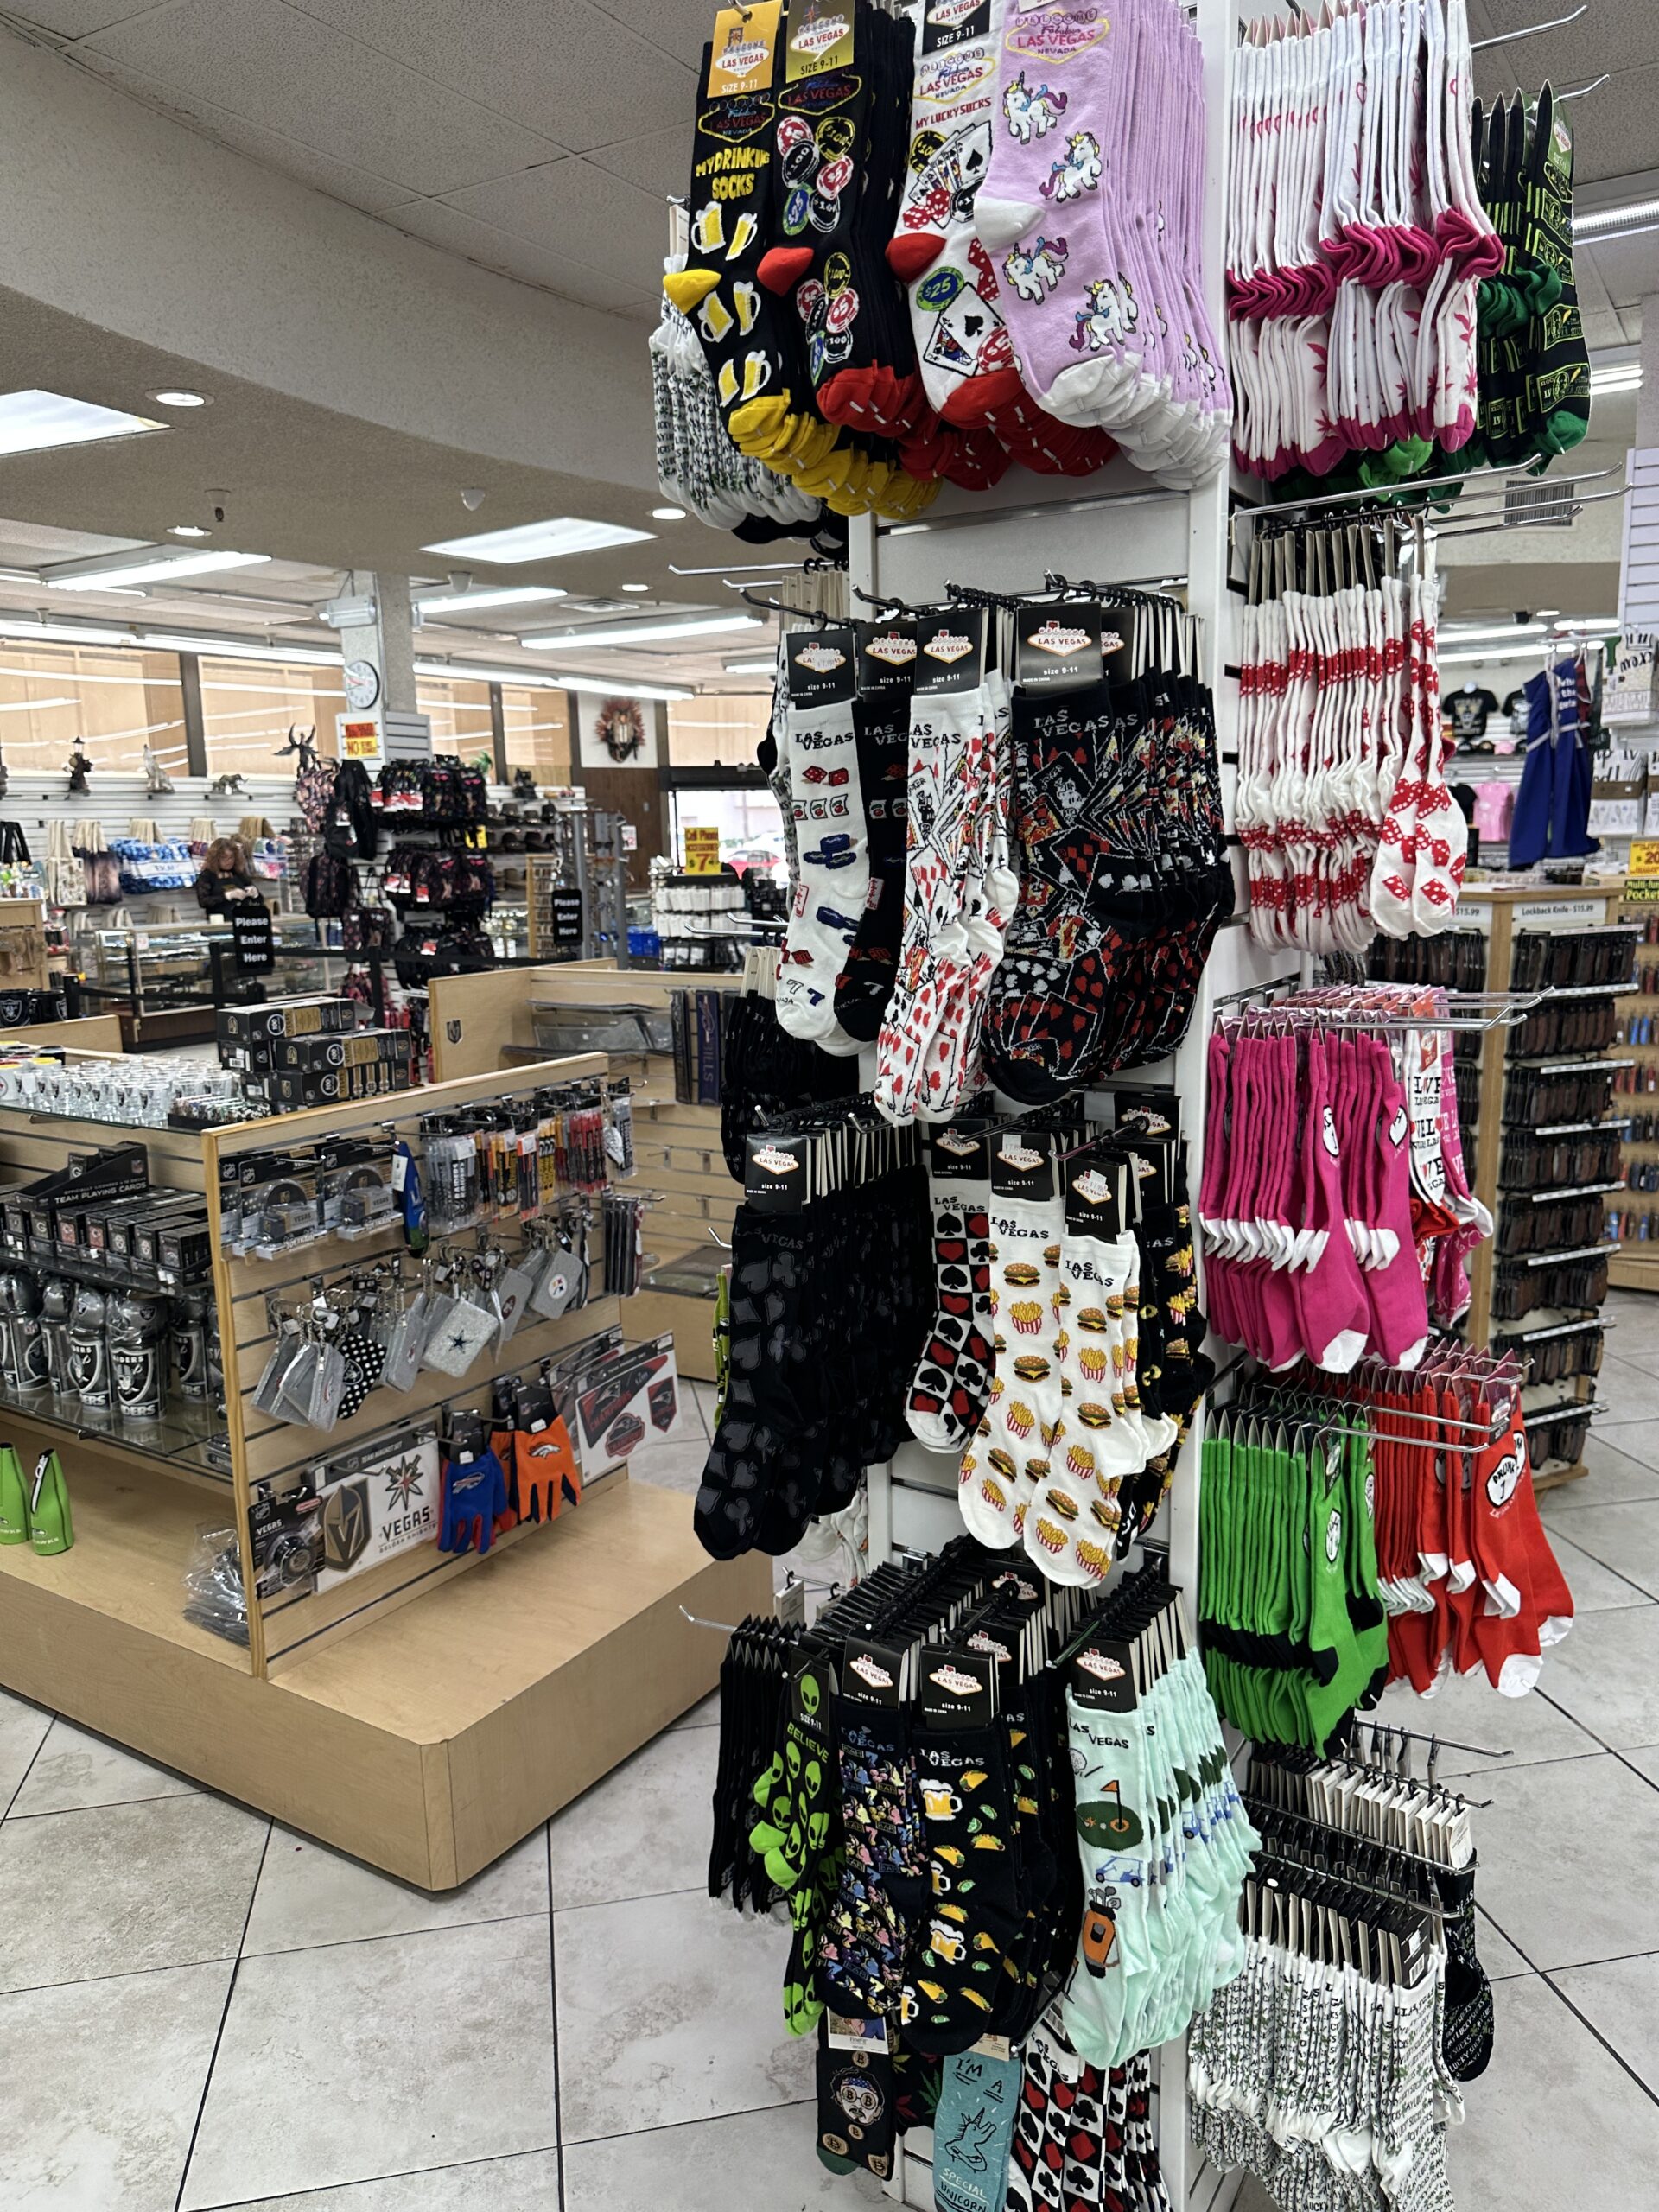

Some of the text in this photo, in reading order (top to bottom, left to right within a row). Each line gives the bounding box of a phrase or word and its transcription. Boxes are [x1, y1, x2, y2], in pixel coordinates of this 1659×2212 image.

[935, 0, 982, 21] LAS VEGAS
[798, 28, 844, 49] LAS VEGAS
[937, 25, 975, 48] SIZE 9-11
[1018, 30, 1096, 48] LAS VEGAS
[1037, 46, 1077, 55] NEVADA
[722, 53, 764, 68] LAS VEGAS
[801, 55, 838, 75] SIZE 9-11
[721, 79, 758, 94] SIZE 9-11
[919, 67, 984, 96] LAS VEGAS
[788, 84, 851, 106] LAS VEGAS
[935, 85, 967, 99] NEVADA
[732, 112, 766, 129] VEGAS
[916, 97, 992, 130] MY LUCKY SOCKS
[712, 173, 755, 200] SOCKS
[924, 277, 951, 297] $25
[947, 673, 960, 682] 9-11
[1033, 709, 1069, 728] LAS
[1042, 715, 1109, 737] VEGAS
[796, 731, 823, 743] LAS
[864, 724, 894, 736] LAS
[803, 733, 854, 751] VEGAS
[875, 733, 907, 746] VEG
[554, 899, 580, 907] Please
[557, 912, 578, 921] Enter
[1522, 905, 1594, 917] Lockback Knife $15.99
[235, 918, 268, 927] Please
[240, 935, 267, 944] Enter
[244, 953, 267, 963] Here
[786, 978, 804, 995] 7
[864, 981, 884, 996] 7
[807, 988, 825, 1007] 7
[54, 1182, 147, 1204] TEAM PLAYING CARDS
[1077, 1184, 1089, 1192] LAS
[373, 1195, 389, 1205] VEGAS
[934, 1196, 958, 1205] LAS
[294, 1211, 312, 1223] VEGAS
[990, 1217, 1017, 1229] LAS
[1091, 1213, 1103, 1222] 9-11
[1000, 1226, 1049, 1239] VEGAS
[256, 1518, 283, 1535] VEGAS
[382, 1505, 431, 1541] VEGAS
[856, 1666, 889, 1685] LAS VEGAS
[1099, 1664, 1121, 1674] VEGAS
[938, 1675, 978, 1690] LAS VEGAS
[870, 1695, 881, 1705] 9-11
[800, 1713, 821, 1730] SIZE 9-11
[1069, 1717, 1089, 1733] LAS
[787, 1722, 829, 1764] BELIEVE
[1089, 1733, 1128, 1749] VEGAS
[866, 1751, 878, 1763] 7
[920, 1748, 950, 1759] LAS
[928, 1757, 985, 1766] VEGAS
[1455, 2016, 1471, 2039] LUCKY
[956, 2057, 983, 2077] I'M
[1449, 2050, 1469, 2073] LUCKY
[991, 2079, 1002, 2093] A
[943, 2167, 987, 2198] SPECIAL
[941, 2181, 986, 2212] UNICORN
